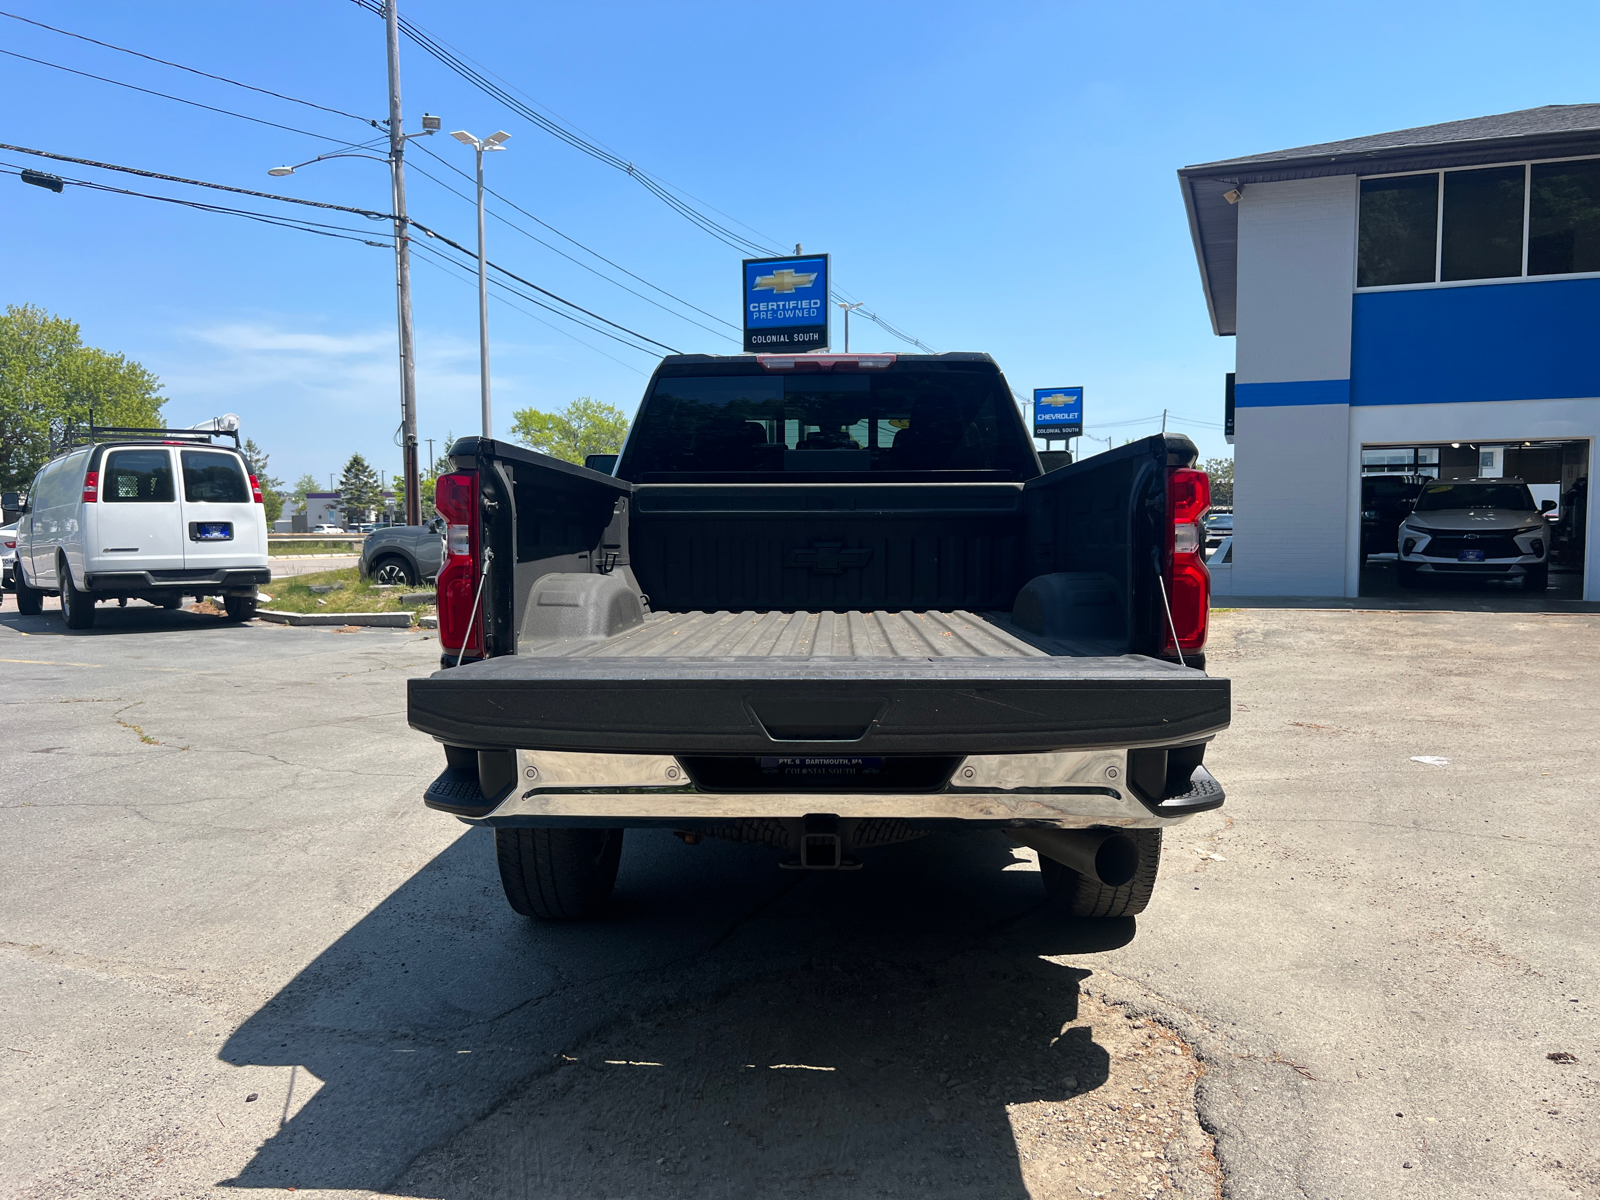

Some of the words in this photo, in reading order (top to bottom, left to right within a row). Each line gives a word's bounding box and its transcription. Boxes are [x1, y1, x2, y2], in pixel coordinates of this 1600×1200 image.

[749, 299, 821, 312] CERTIFIED
[753, 309, 817, 320] PRE-OWNED
[751, 334, 789, 344] COLONIAL
[793, 332, 819, 342] SOUTH
[1037, 412, 1079, 421] CHEVROLET
[805, 758, 851, 766] DARTMOUTH,
[784, 767, 827, 775] COLNIAL
